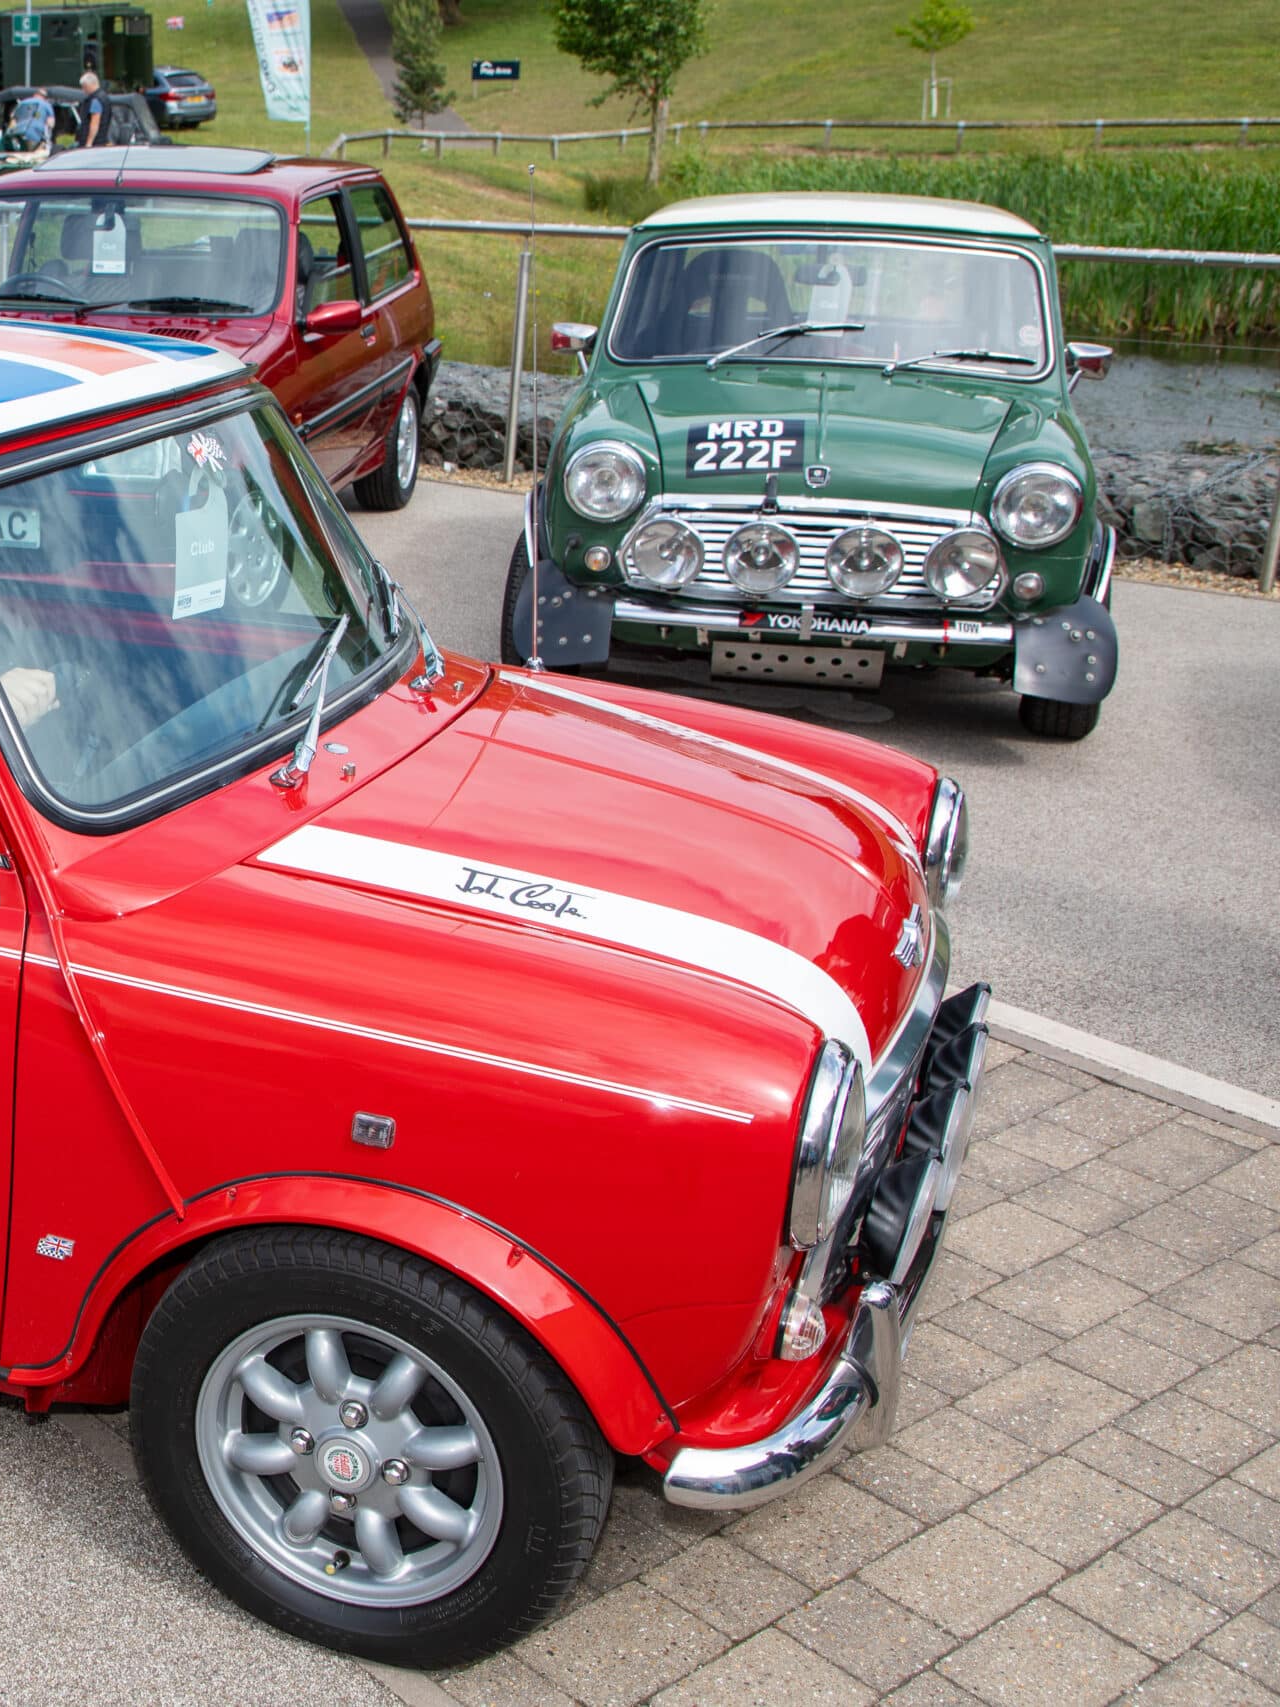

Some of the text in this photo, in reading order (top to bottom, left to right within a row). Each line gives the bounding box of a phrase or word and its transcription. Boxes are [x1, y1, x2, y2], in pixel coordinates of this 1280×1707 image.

[707, 419, 785, 440] MRD
[693, 439, 797, 471] 222F
[190, 536, 215, 556] Club
[958, 622, 980, 634] TOW
